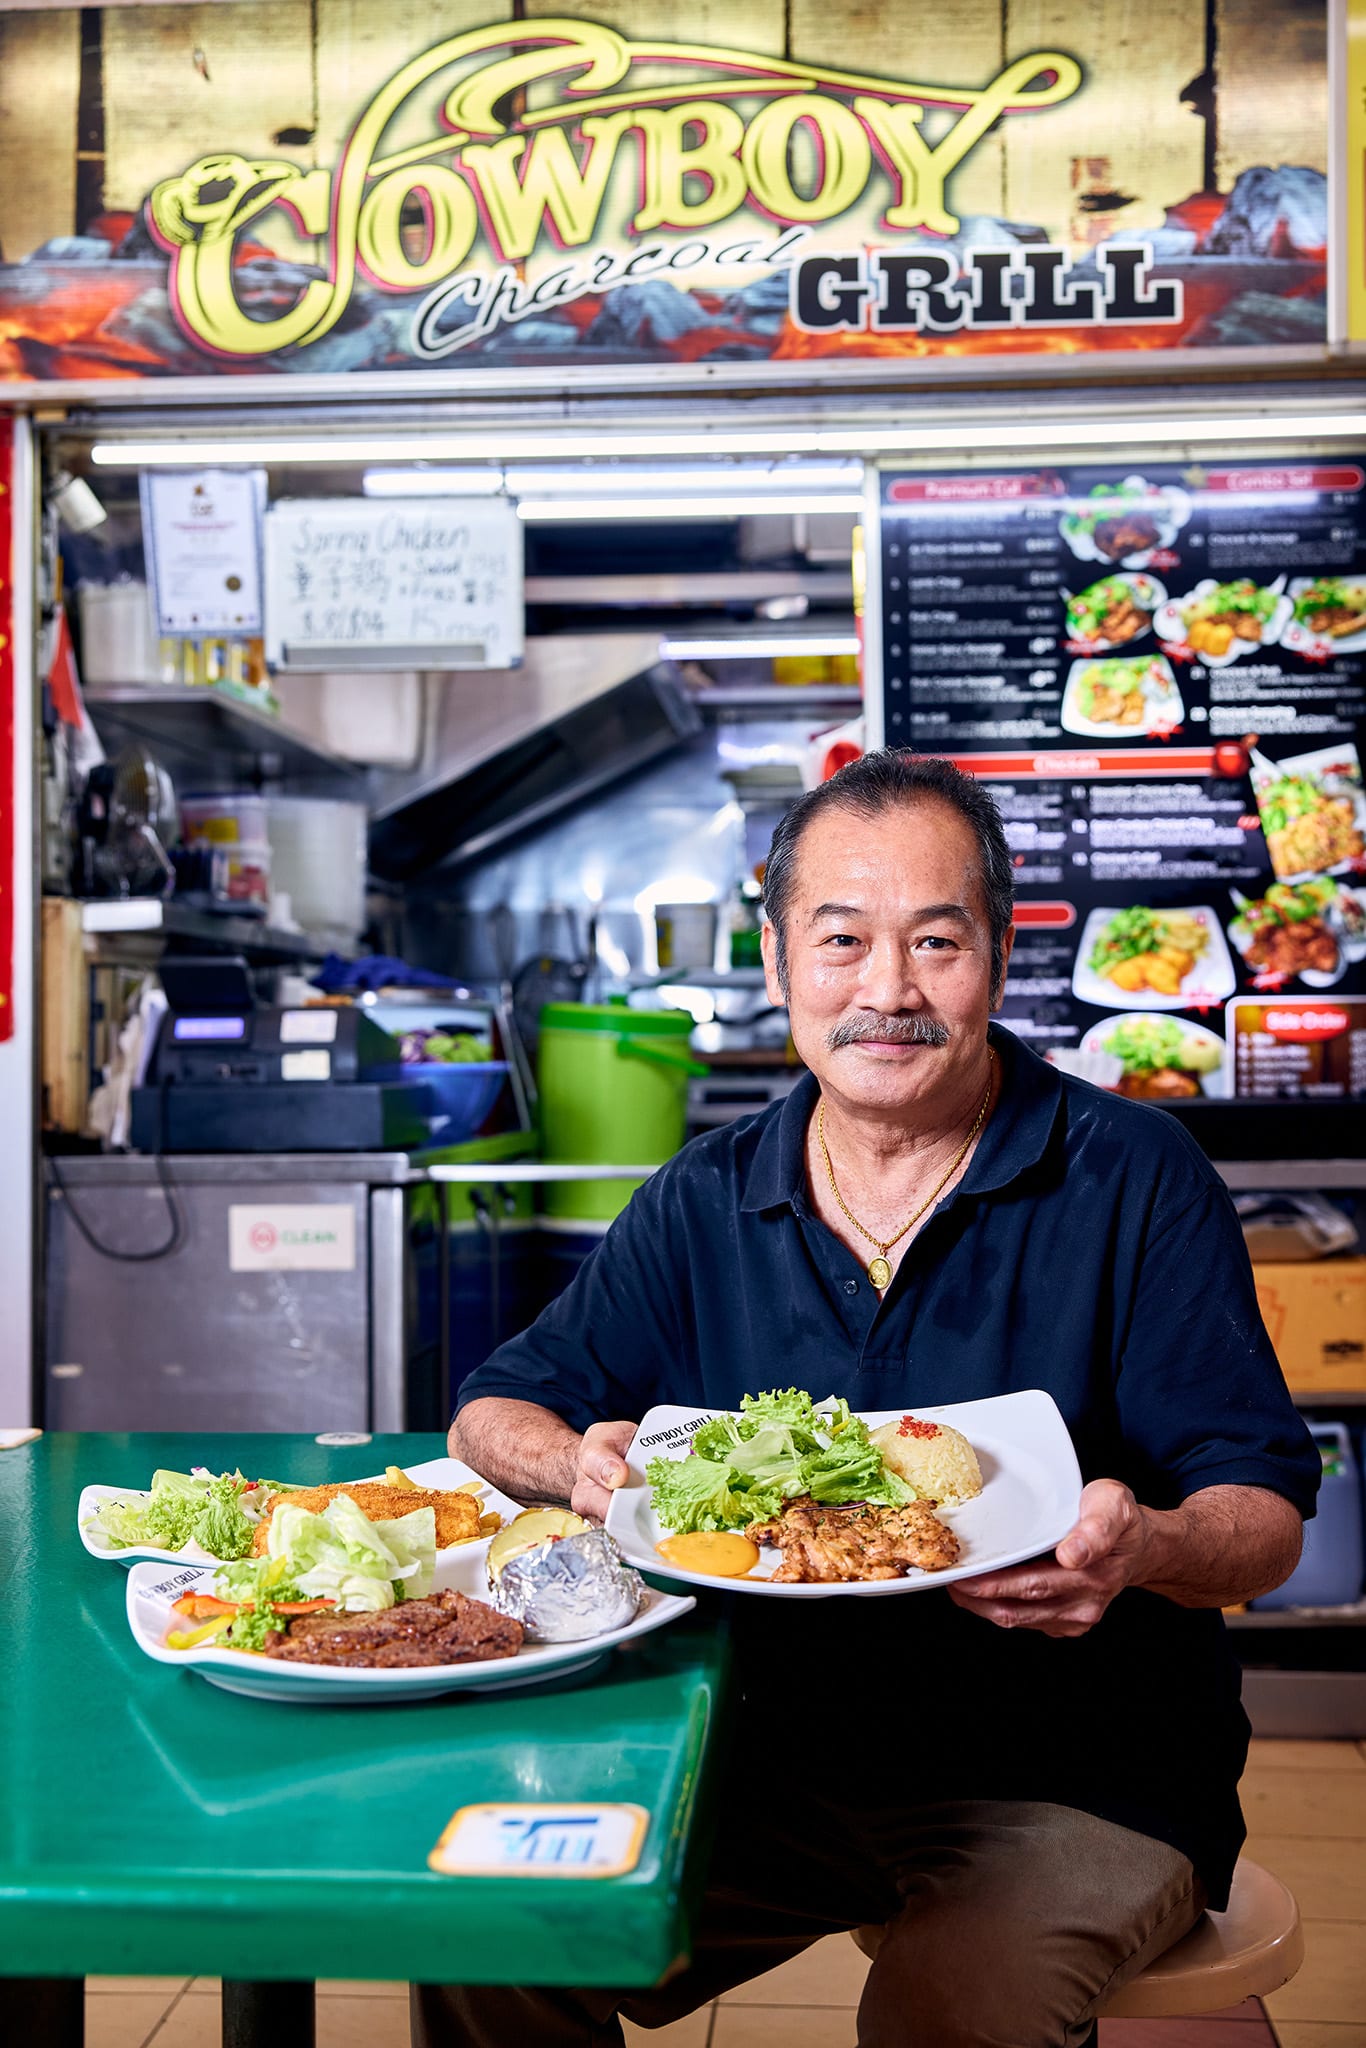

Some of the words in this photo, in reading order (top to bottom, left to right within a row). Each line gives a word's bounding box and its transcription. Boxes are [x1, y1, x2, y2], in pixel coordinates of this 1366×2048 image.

[413, 224, 807, 359] Charcoal
[789, 242, 1185, 333] GRILL
[639, 1426, 684, 1447] COWBOY
[666, 1437, 692, 1450] CHARC
[173, 1568, 205, 1586] GRILL
